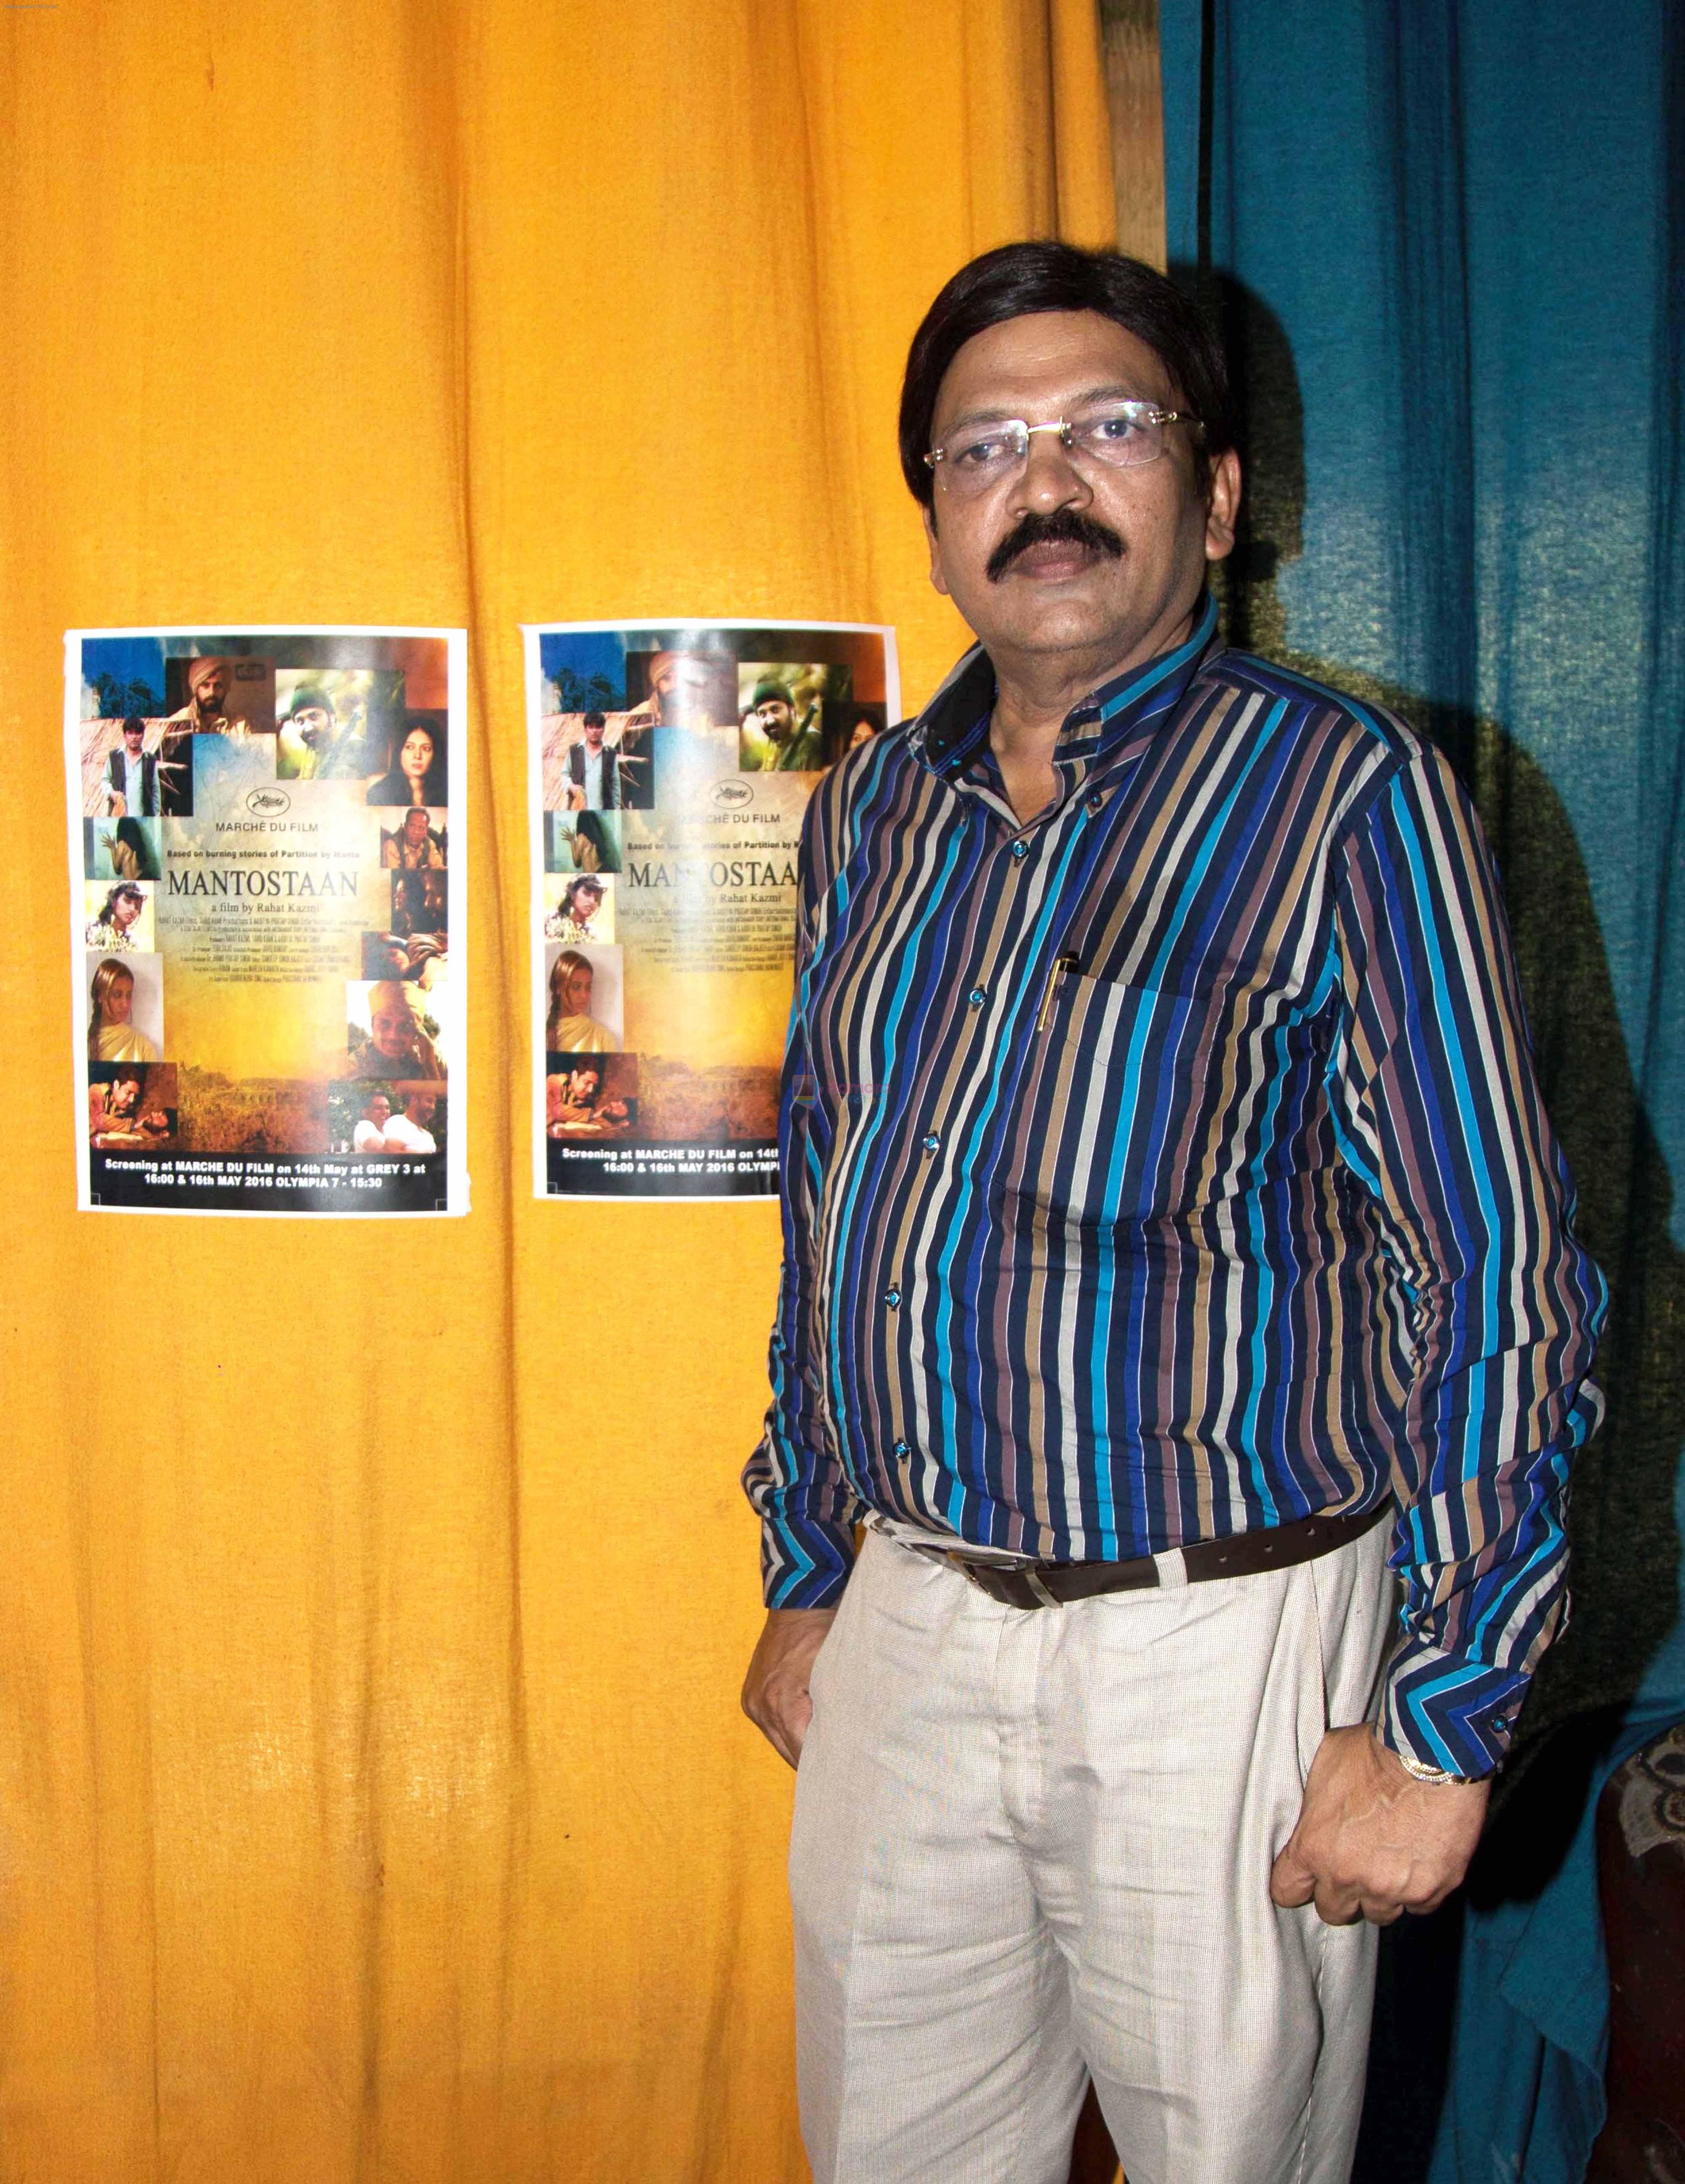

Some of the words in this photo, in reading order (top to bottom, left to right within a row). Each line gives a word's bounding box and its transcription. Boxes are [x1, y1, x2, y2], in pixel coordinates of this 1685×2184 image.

[733, 814, 749, 823] DU
[753, 814, 780, 823] FILM
[216, 821, 265, 832] MARCHÉ
[270, 823, 286, 832] DU
[291, 823, 318, 832] FILM
[783, 841, 791, 849] by
[206, 850, 236, 859] burning
[321, 850, 330, 859] by
[168, 870, 358, 896] MANTOSTAAN
[720, 893, 747, 902] Rahat
[751, 893, 781, 902] Kazmi
[220, 902, 239, 912] film
[242, 902, 254, 914] by
[257, 902, 284, 912] Rahat
[288, 903, 320, 912] Kazmi
[562, 1148, 616, 1159] Screening
[621, 1149, 632, 1159] at
[636, 1149, 685, 1159] MARCHE
[688, 1149, 704, 1159] DU
[709, 1149, 736, 1159] FILM
[105, 1159, 158, 1172] Screening
[161, 1161, 172, 1171] at
[175, 1161, 223, 1172] MARCHE
[227, 1162, 243, 1172] DU
[246, 1162, 274, 1173] FILM
[295, 1164, 321, 1173] 14th
[324, 1164, 348, 1176] May
[350, 1164, 363, 1174] at
[366, 1164, 399, 1174] GREY
[403, 1164, 410, 1174] 3
[413, 1164, 425, 1174] at
[603, 1162, 633, 1172] 16:00
[638, 1163, 646, 1172] &
[650, 1162, 674, 1172] 16th
[679, 1162, 703, 1172] MAY
[706, 1162, 734, 1172] 2016
[738, 1161, 780, 1172] OLYMPI
[144, 1173, 174, 1184] 16:00
[177, 1175, 186, 1185] &
[190, 1175, 214, 1185] 16th
[217, 1176, 242, 1186] MAY
[244, 1177, 272, 1186] 2016
[275, 1177, 329, 1187] OLYMPIA
[330, 1177, 339, 1187] 7
[350, 1177, 382, 1188] 15:30
